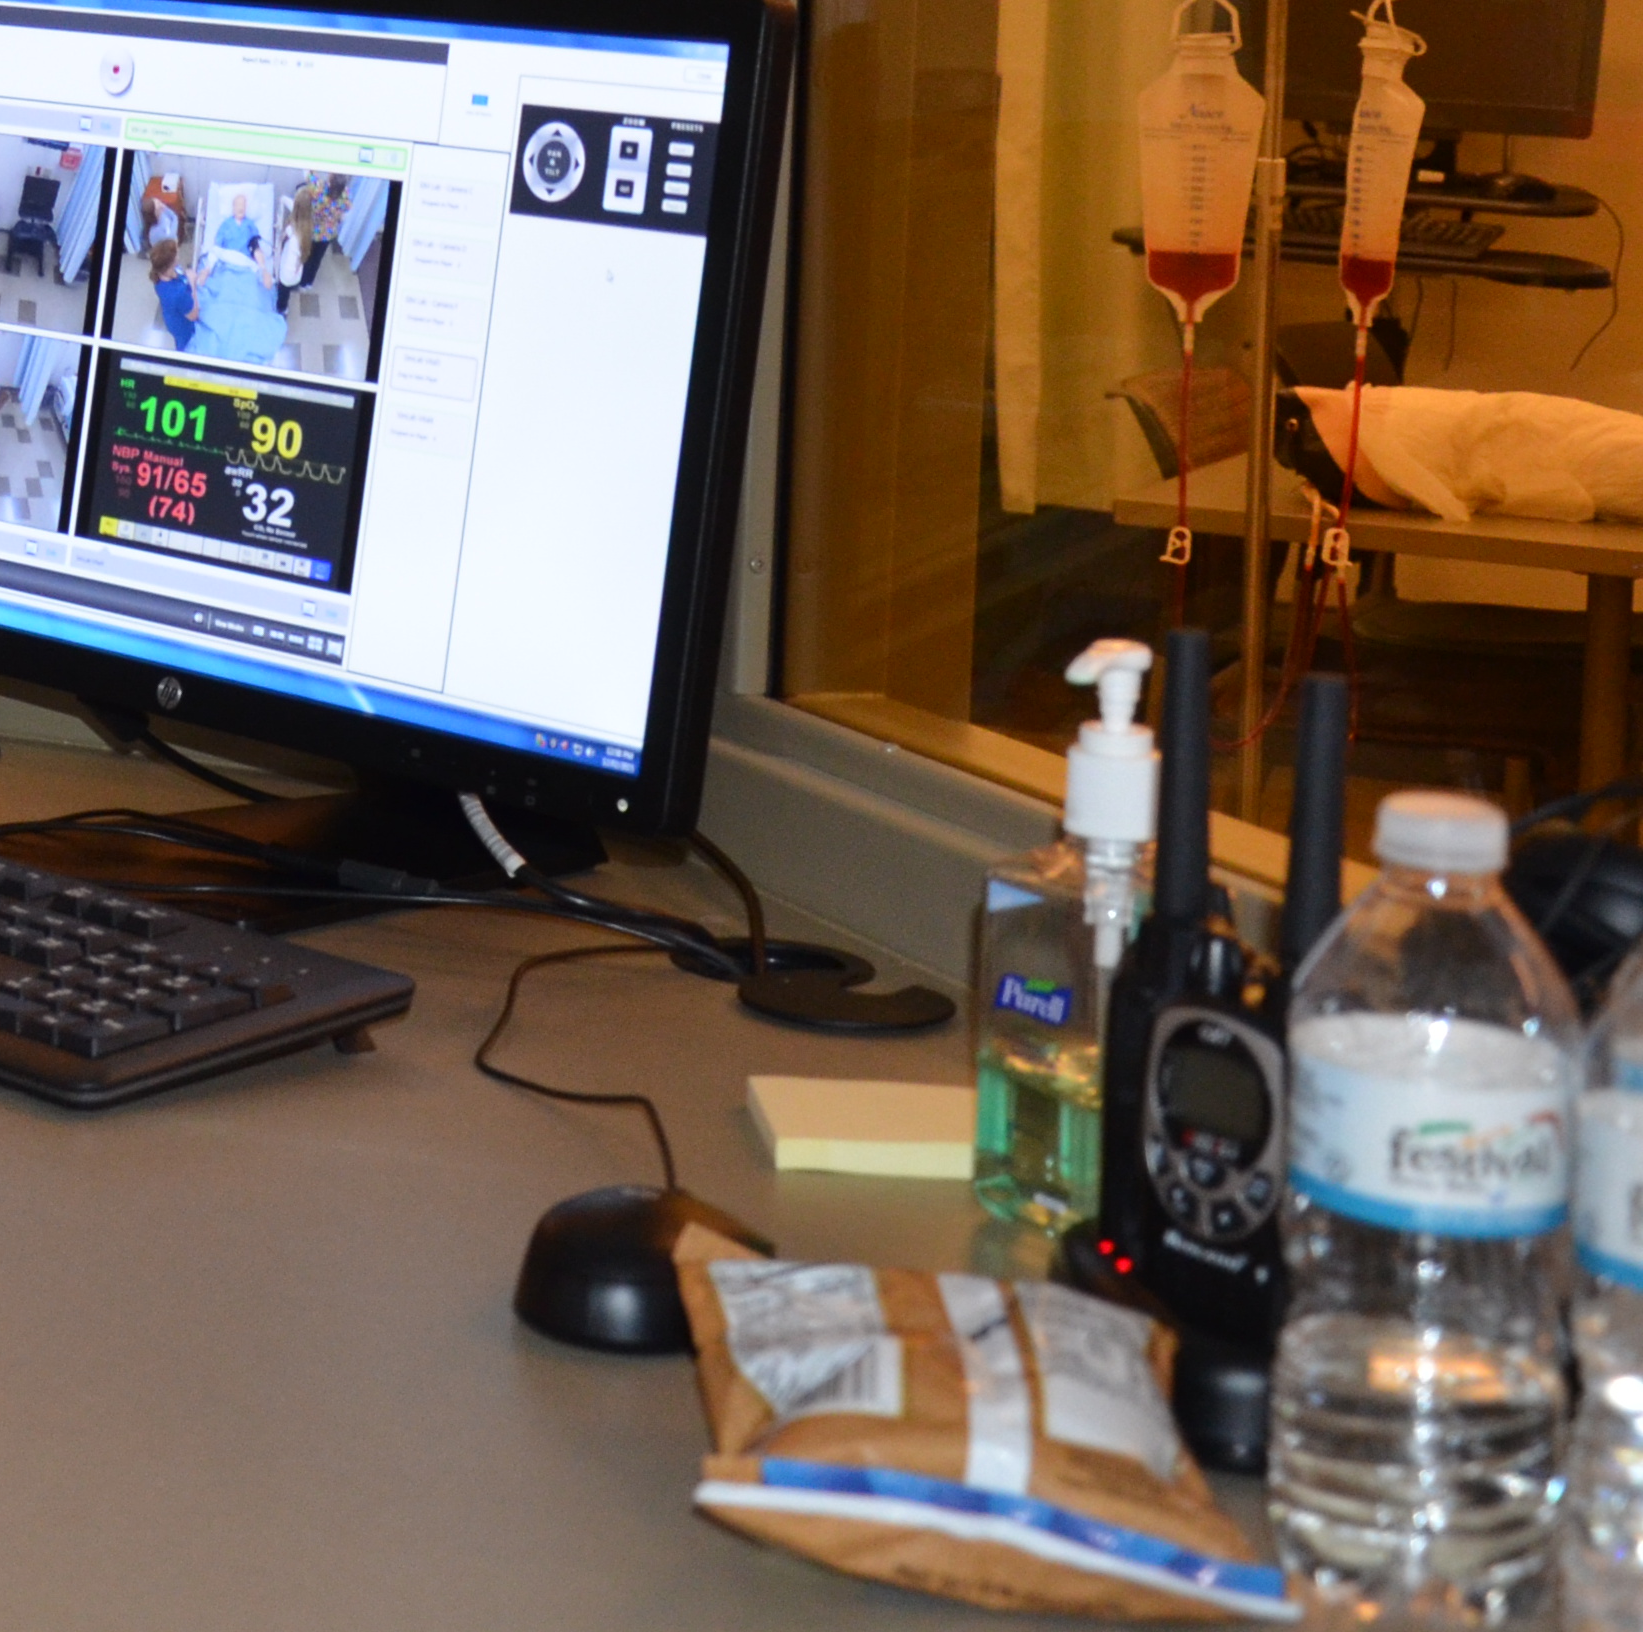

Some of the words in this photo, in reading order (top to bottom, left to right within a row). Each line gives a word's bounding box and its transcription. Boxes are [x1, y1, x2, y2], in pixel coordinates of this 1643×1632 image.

[120, 378, 135, 389] HR
[140, 396, 208, 442] 101
[251, 415, 303, 460] 90
[112, 444, 140, 460] NBP
[143, 449, 185, 468] Manual
[136, 461, 209, 498] 91/65
[224, 466, 254, 480] awRR
[148, 495, 196, 526] (74)
[241, 482, 295, 529] 32
[157, 677, 182, 709] hp
